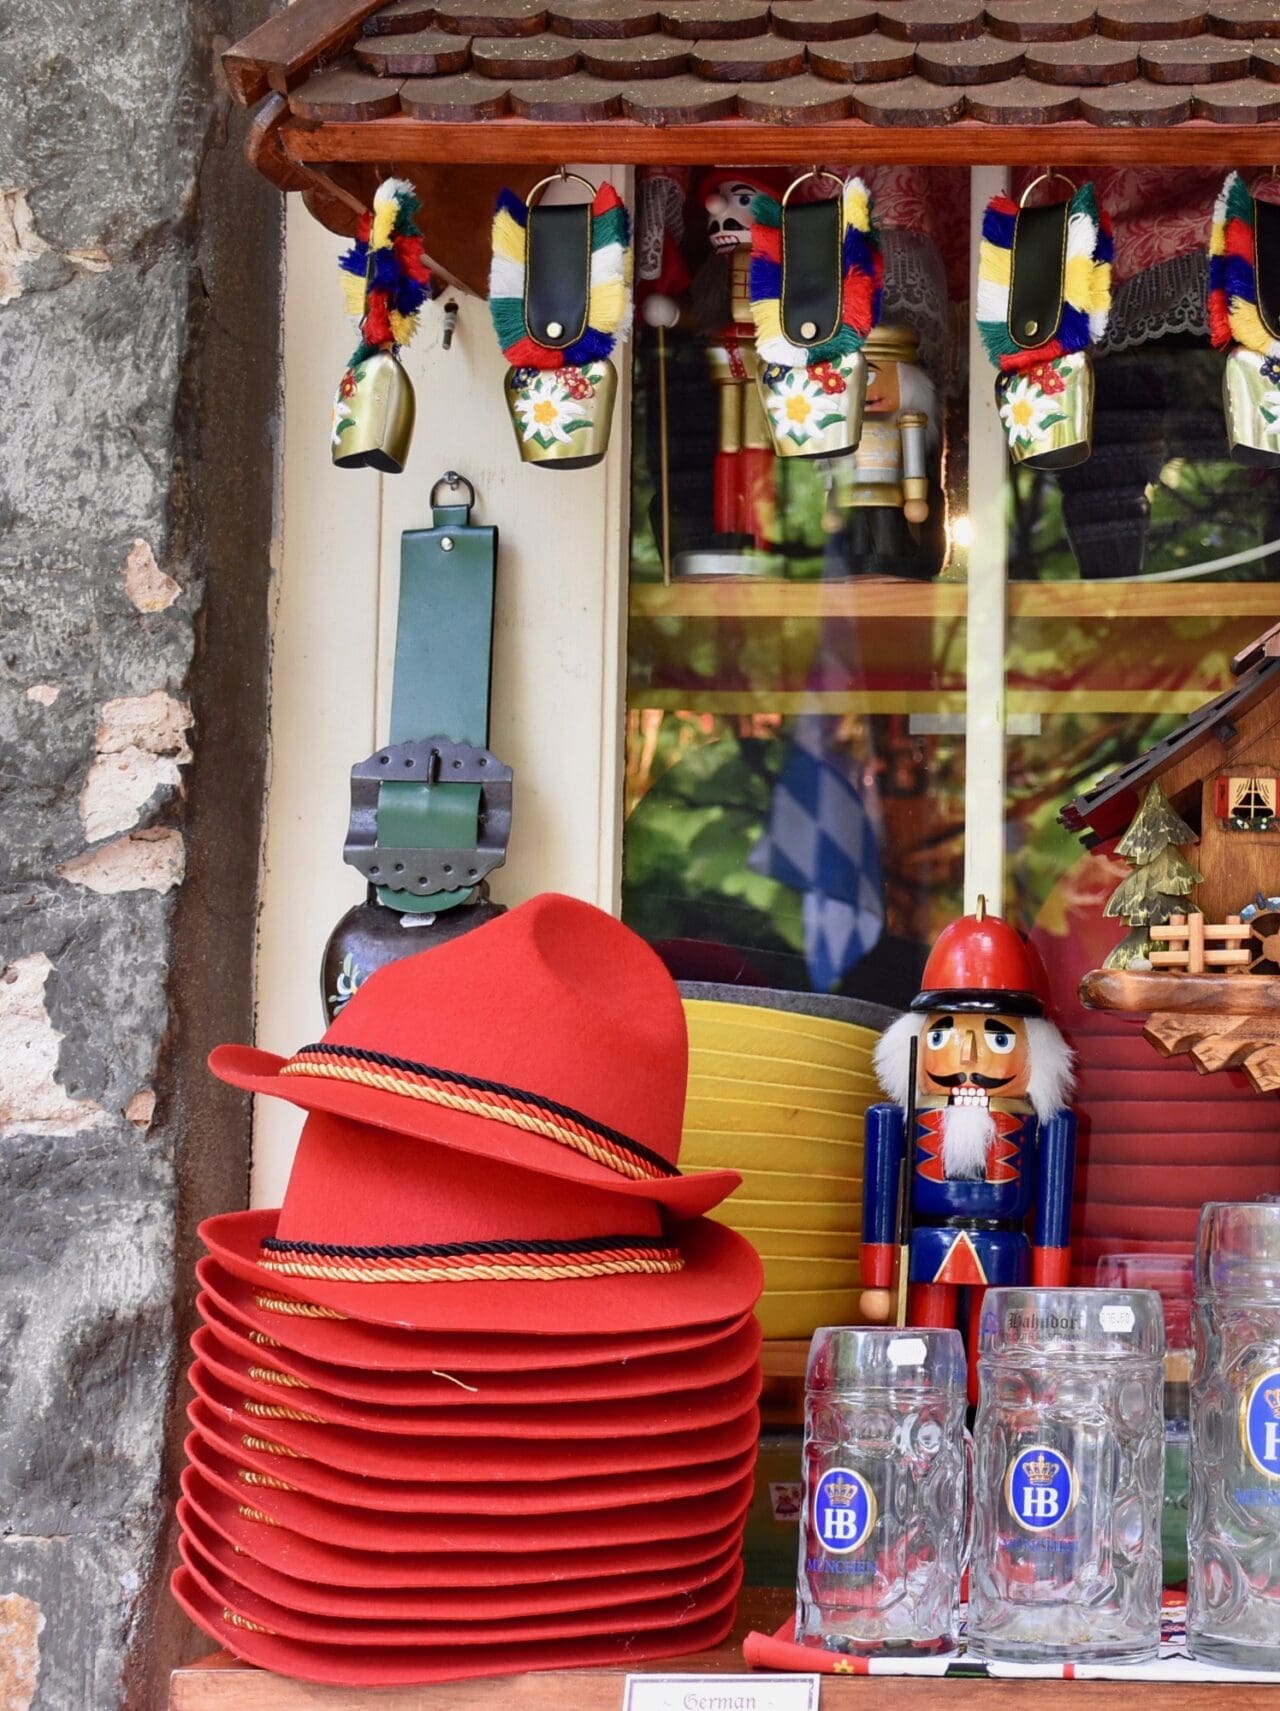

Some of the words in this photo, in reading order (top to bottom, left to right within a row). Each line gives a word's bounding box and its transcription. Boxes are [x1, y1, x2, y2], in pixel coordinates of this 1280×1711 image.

[1022, 1486, 1059, 1517] HB
[823, 1508, 858, 1539] HB
[682, 1693, 756, 1711] German
